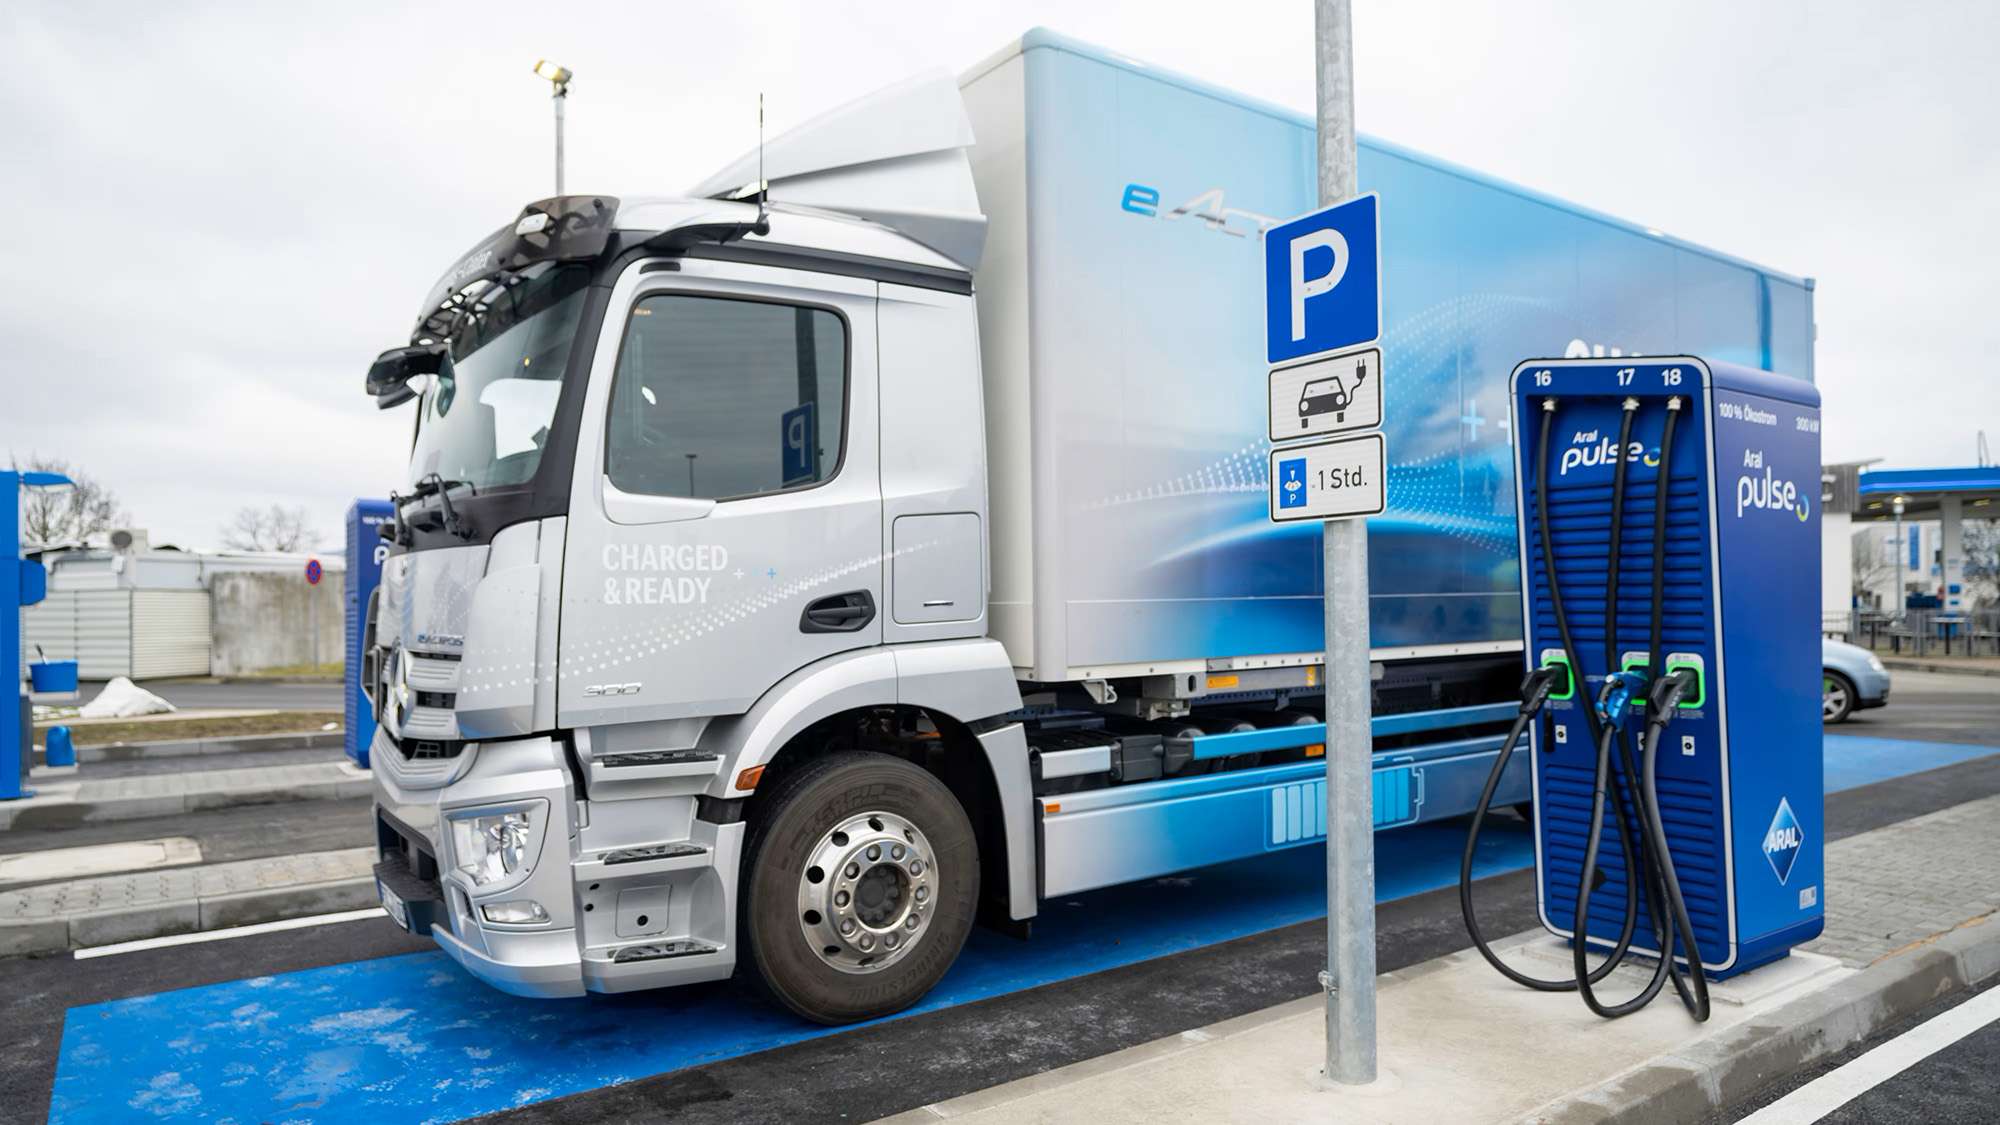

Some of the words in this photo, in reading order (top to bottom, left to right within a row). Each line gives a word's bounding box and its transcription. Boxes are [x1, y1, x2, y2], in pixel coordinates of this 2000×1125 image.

[1290, 228, 1350, 342] P
[1534, 370, 1552, 387] 16
[1617, 368, 1635, 387] 17
[1661, 368, 1682, 387] 18
[1719, 402, 1734, 418] 100
[1573, 429, 1598, 444] Aral
[1560, 436, 1643, 475] pulse
[1743, 448, 1763, 468] Aral
[1330, 465, 1368, 490] Std.
[1289, 493, 1297, 504] P
[1737, 465, 1797, 518] pulse
[602, 544, 728, 571] CHARGED
[582, 682, 642, 697] 300
[1768, 827, 1799, 853] ARAL
